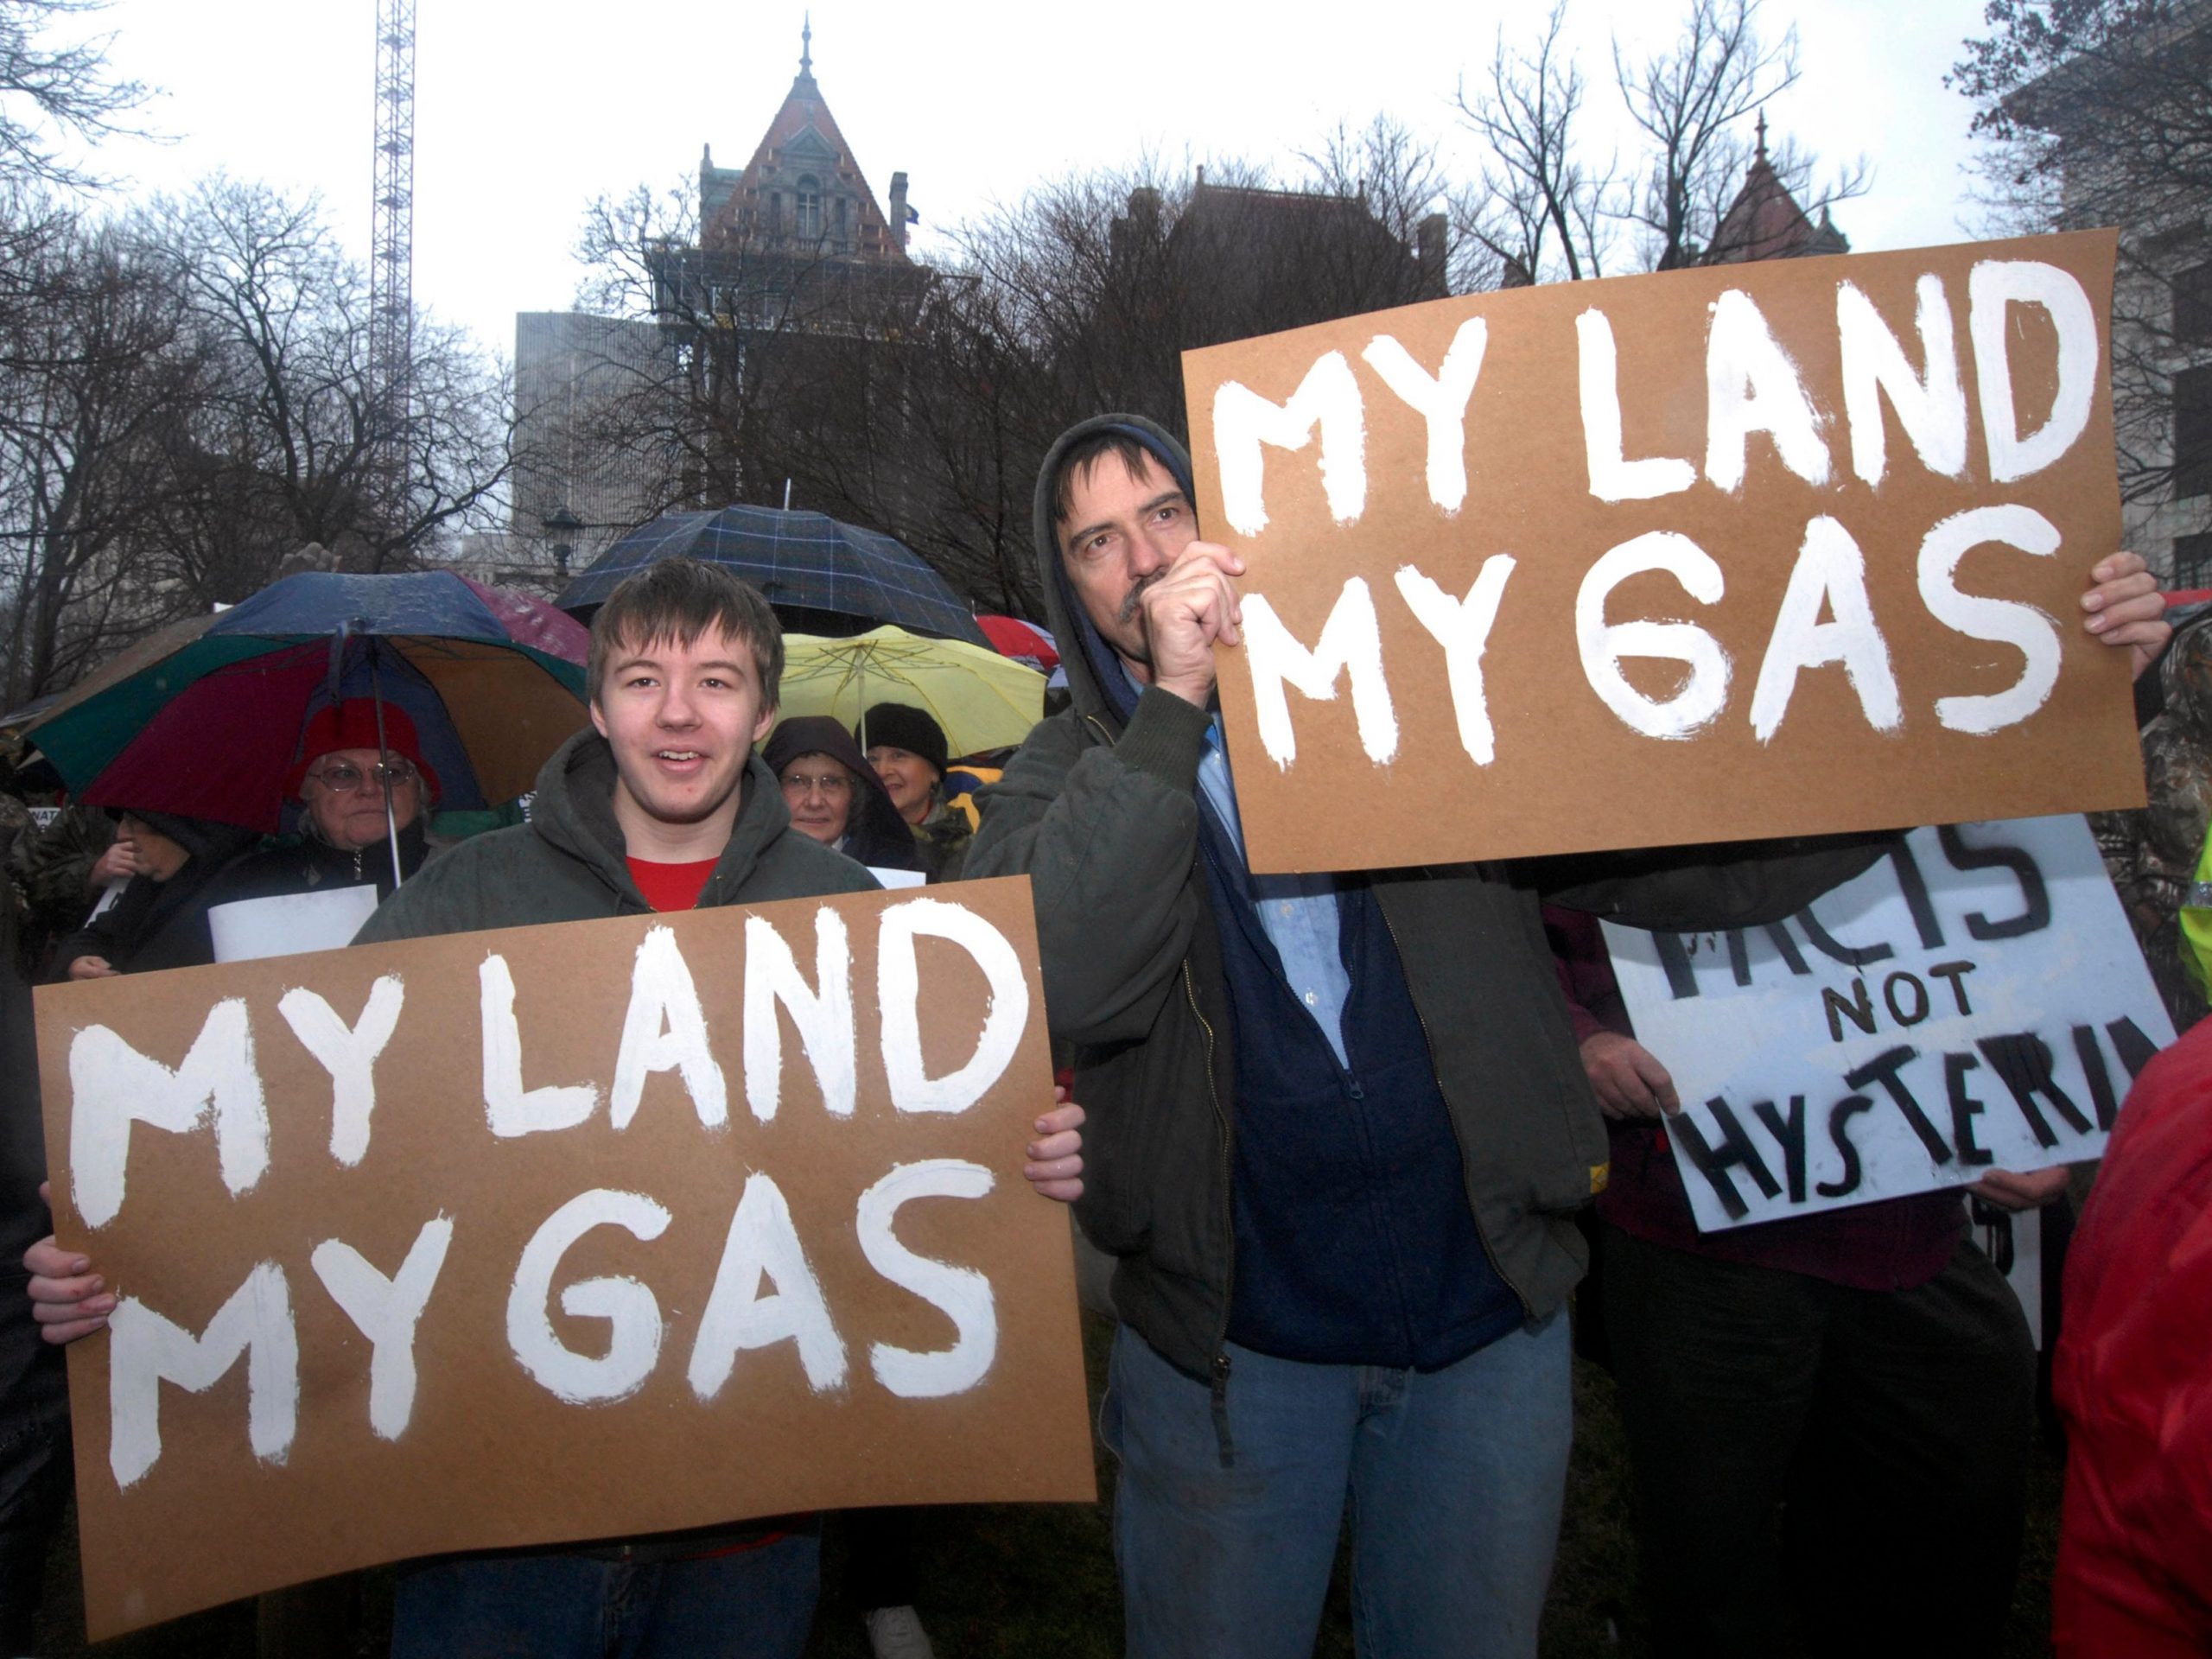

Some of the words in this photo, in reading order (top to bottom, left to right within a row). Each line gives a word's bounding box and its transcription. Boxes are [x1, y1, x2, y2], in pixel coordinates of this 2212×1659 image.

[1211, 315, 1488, 538] MY
[1575, 260, 2099, 504] LAND
[1240, 553, 1517, 772] MY
[1575, 503, 2064, 746] GAS
[68, 970, 404, 1230] MY
[479, 897, 1029, 1138] LAND
[1821, 961, 1976, 1042] NOT
[108, 1210, 454, 1491] MY
[506, 1159, 1000, 1403] GAS
